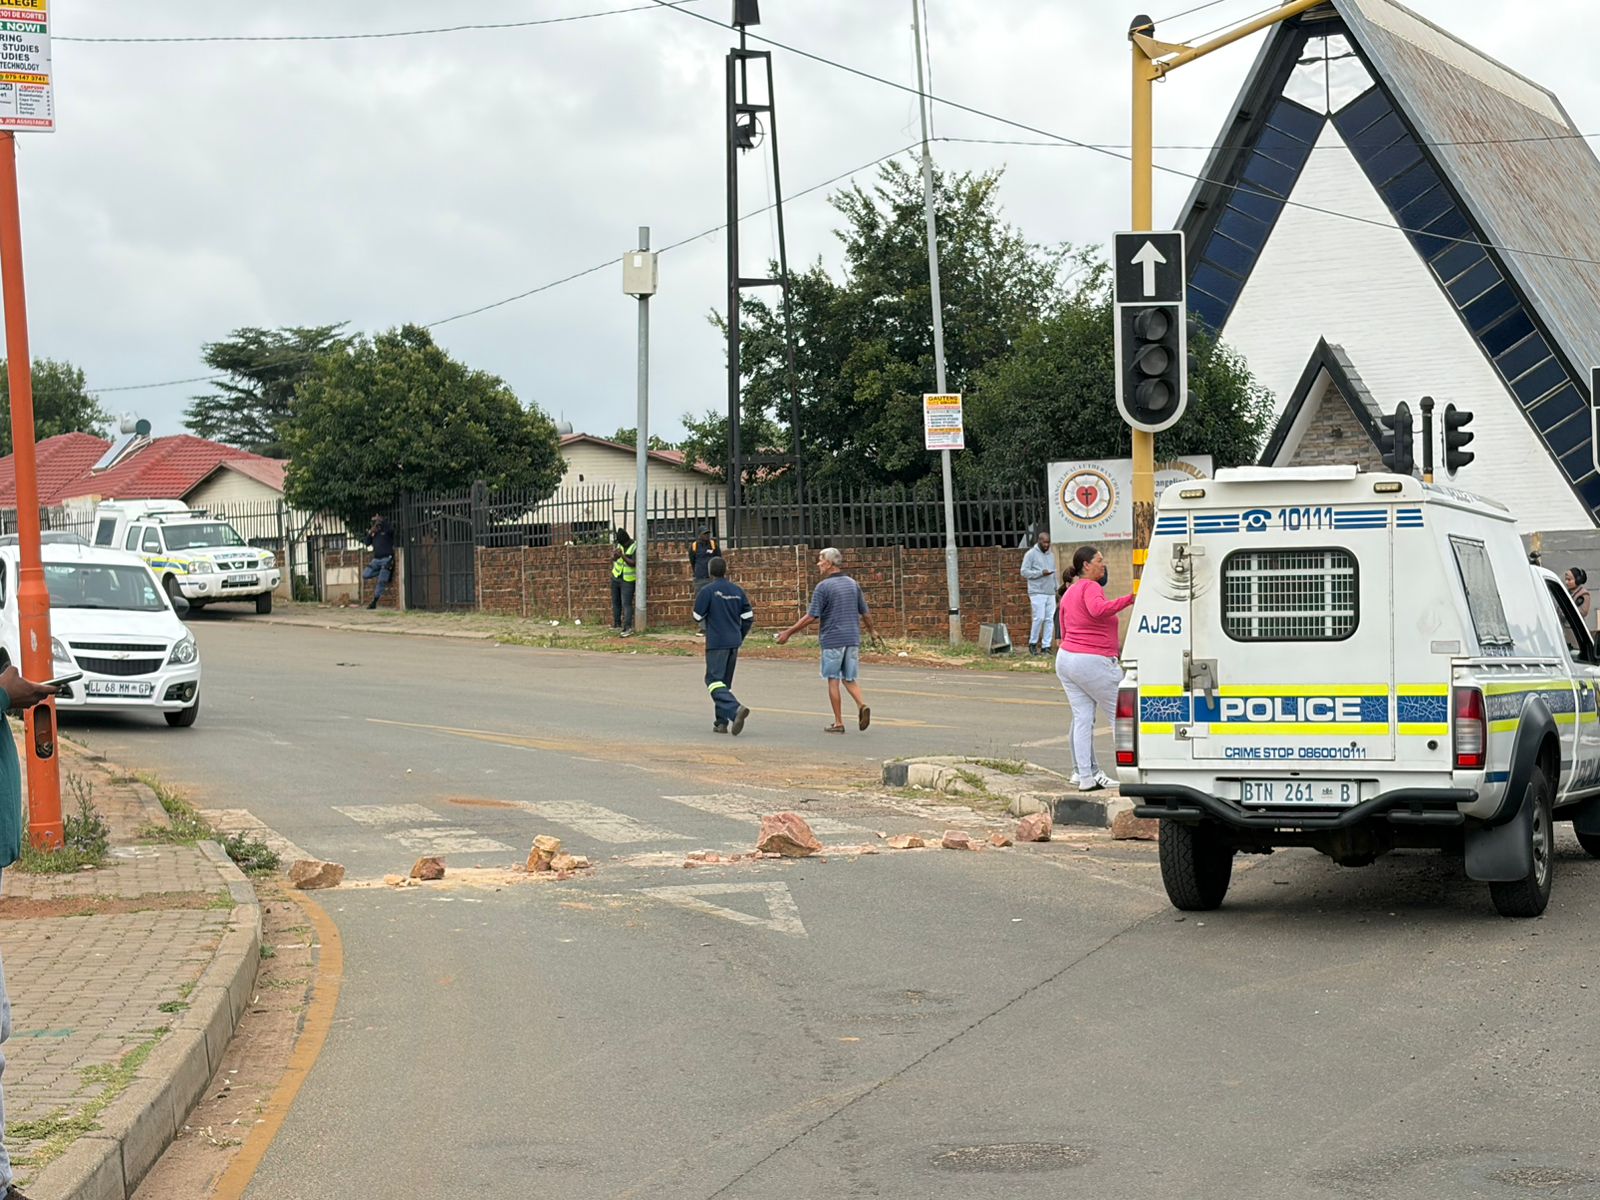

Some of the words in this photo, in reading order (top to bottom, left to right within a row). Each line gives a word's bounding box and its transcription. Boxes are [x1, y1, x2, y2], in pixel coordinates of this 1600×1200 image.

[2, 43, 40, 53] STUDIES
[0, 52, 30, 61] UDIES
[0, 61, 40, 71] TECHNOLOGY
[1155, 478, 1190, 488] angeli
[1278, 507, 1333, 531] 10111
[1138, 615, 1182, 634] AJ23
[90, 682, 101, 692] LL
[104, 682, 116, 693] 68
[138, 684, 150, 694] GP
[1219, 697, 1362, 722] POLICE
[1224, 747, 1261, 758] CRIME
[1263, 747, 1294, 758] STOP
[1298, 747, 1367, 758] 0860010111
[1244, 782, 1273, 801] BTN
[1285, 783, 1314, 802] 261
[1340, 783, 1351, 802] B
